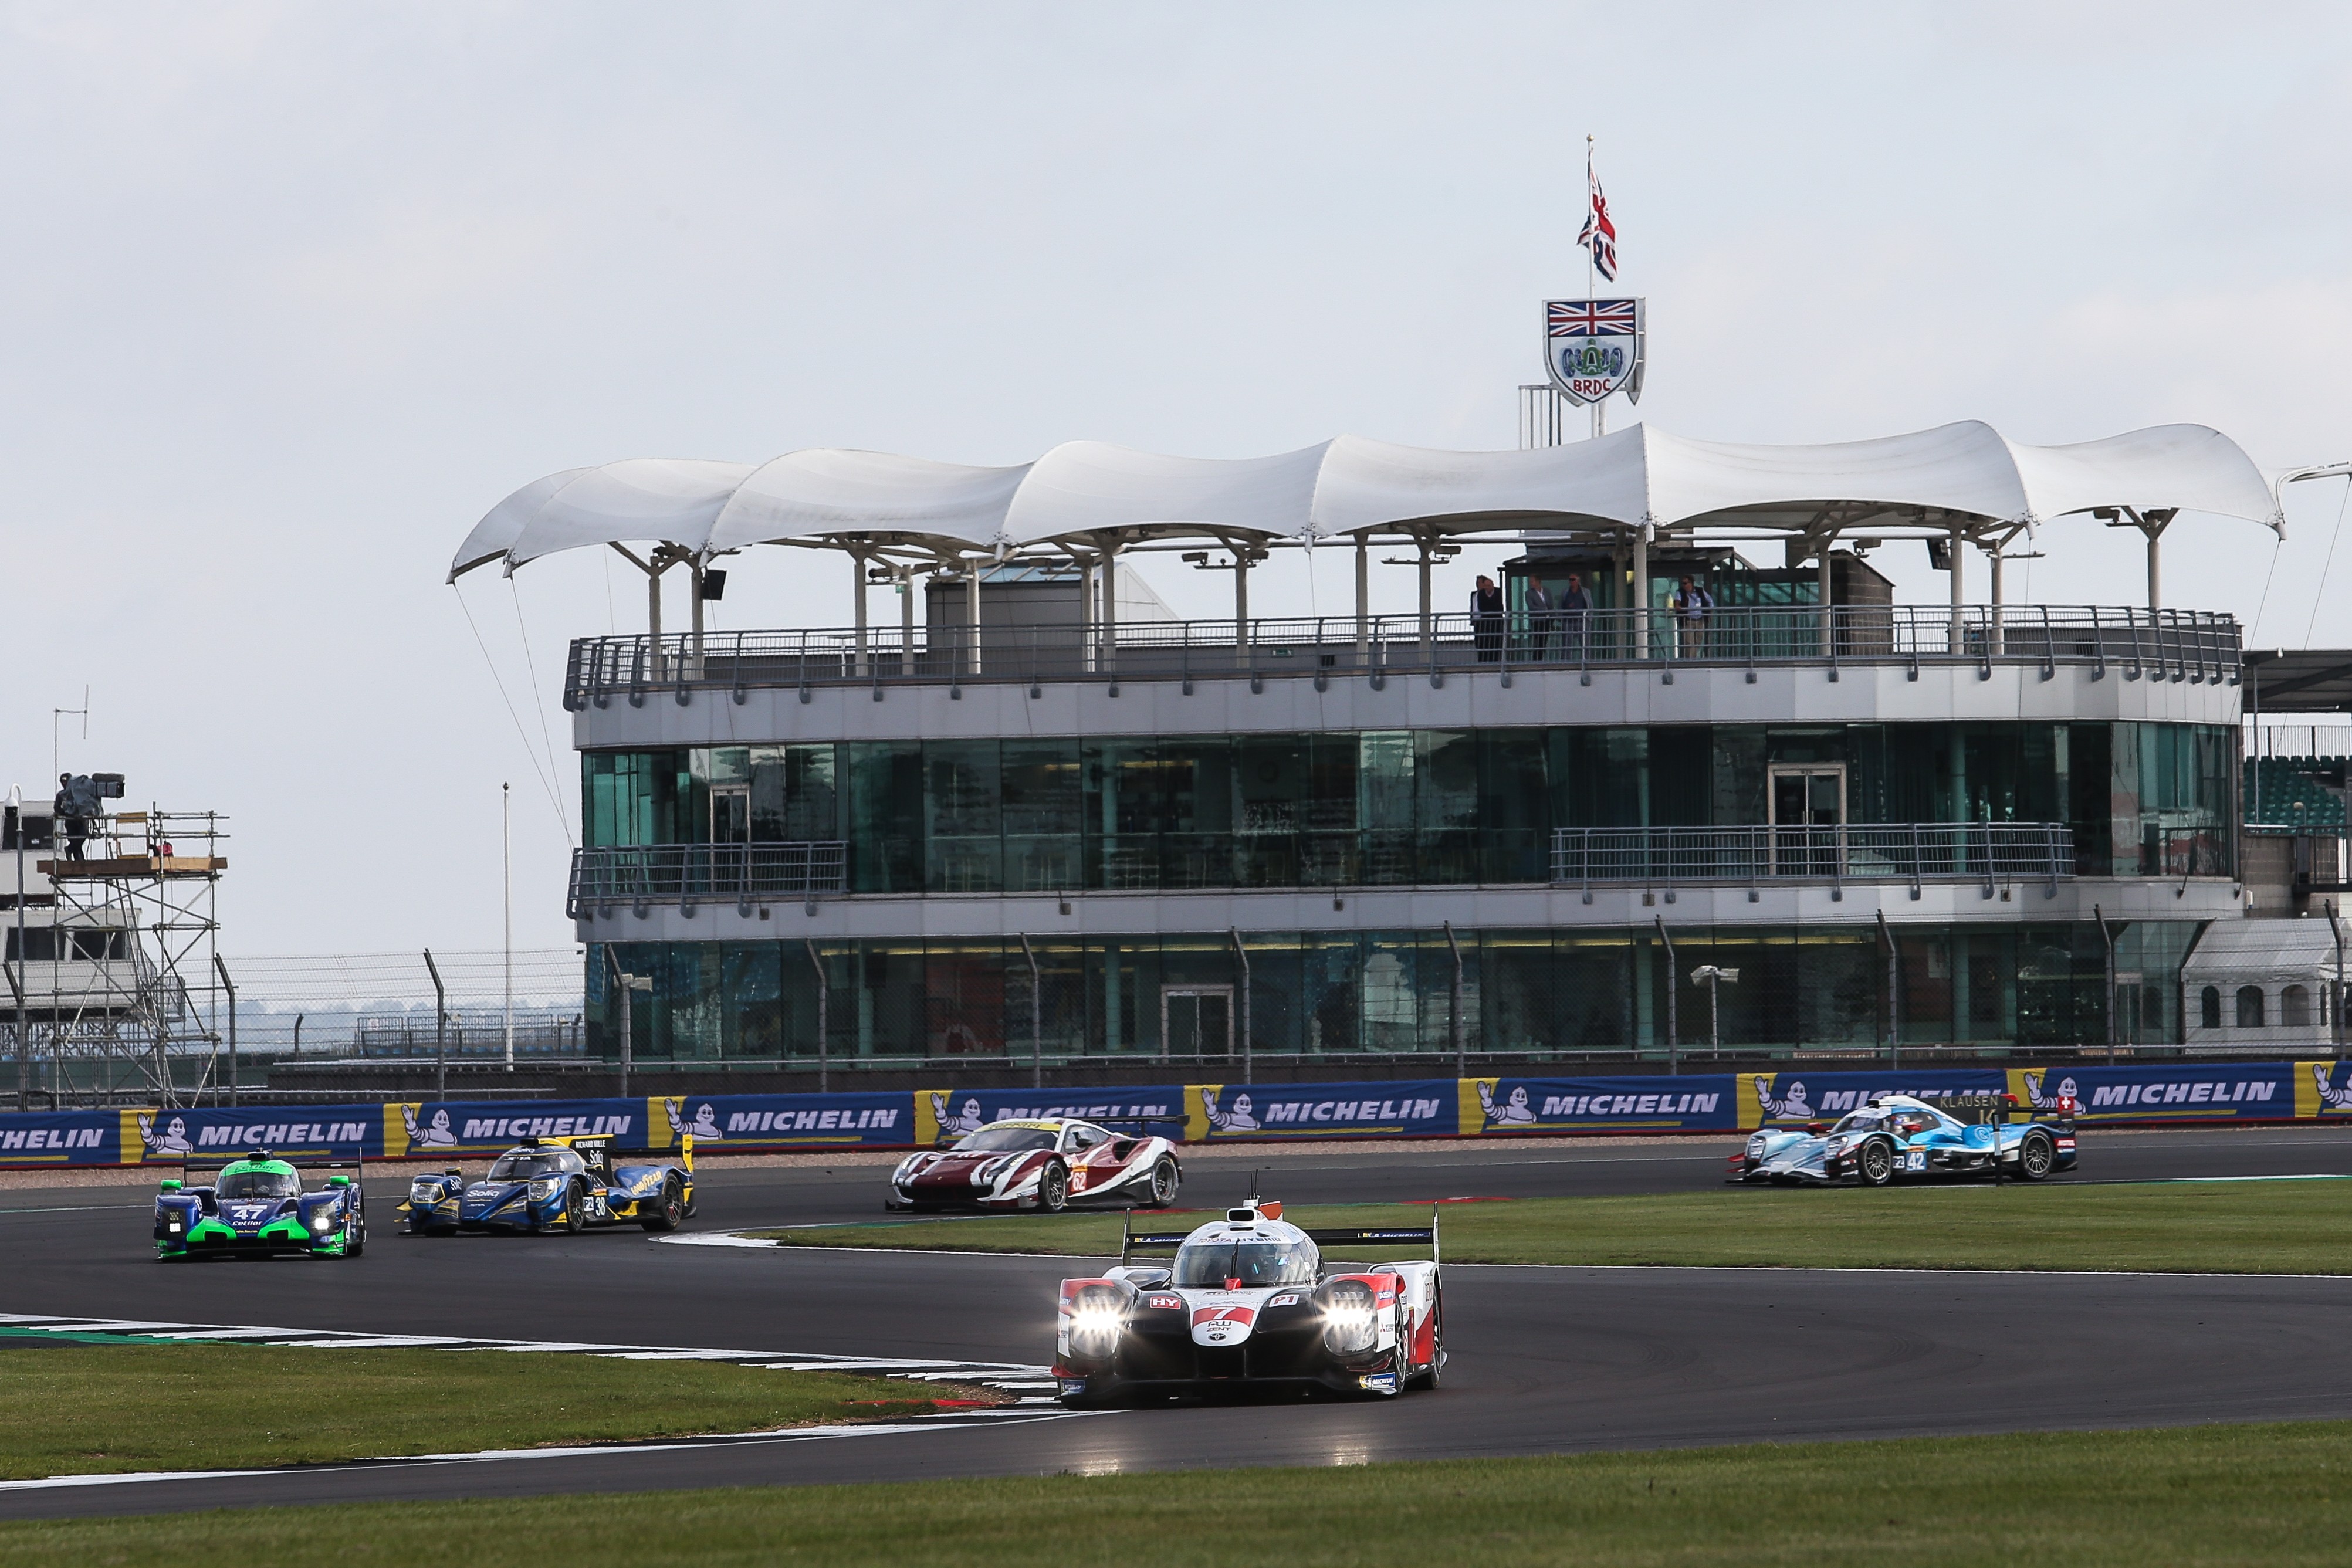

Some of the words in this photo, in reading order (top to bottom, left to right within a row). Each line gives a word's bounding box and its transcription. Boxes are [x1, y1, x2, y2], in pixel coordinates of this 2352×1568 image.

[1573, 378, 1611, 396] BRDC
[1940, 1096, 1998, 1108] KLAUSEN
[2092, 1082, 2276, 1106] MICHELIN
[1265, 1099, 1440, 1122] MICHELIN
[1542, 1093, 1719, 1115] MICHELIN
[463, 1116, 631, 1138] MICHELIN
[727, 1109, 898, 1132] MICHELIN
[0, 1129, 104, 1149] HELIN
[198, 1123, 367, 1146] MICHELIN
[1908, 1152, 1925, 1171] 42
[1072, 1172, 1086, 1190] 62
[233, 1209, 263, 1220] 47
[595, 1197, 605, 1217] 38
[1152, 1298, 1180, 1307] HY
[1274, 1296, 1294, 1304] P1
[1211, 1307, 1236, 1320] 7
